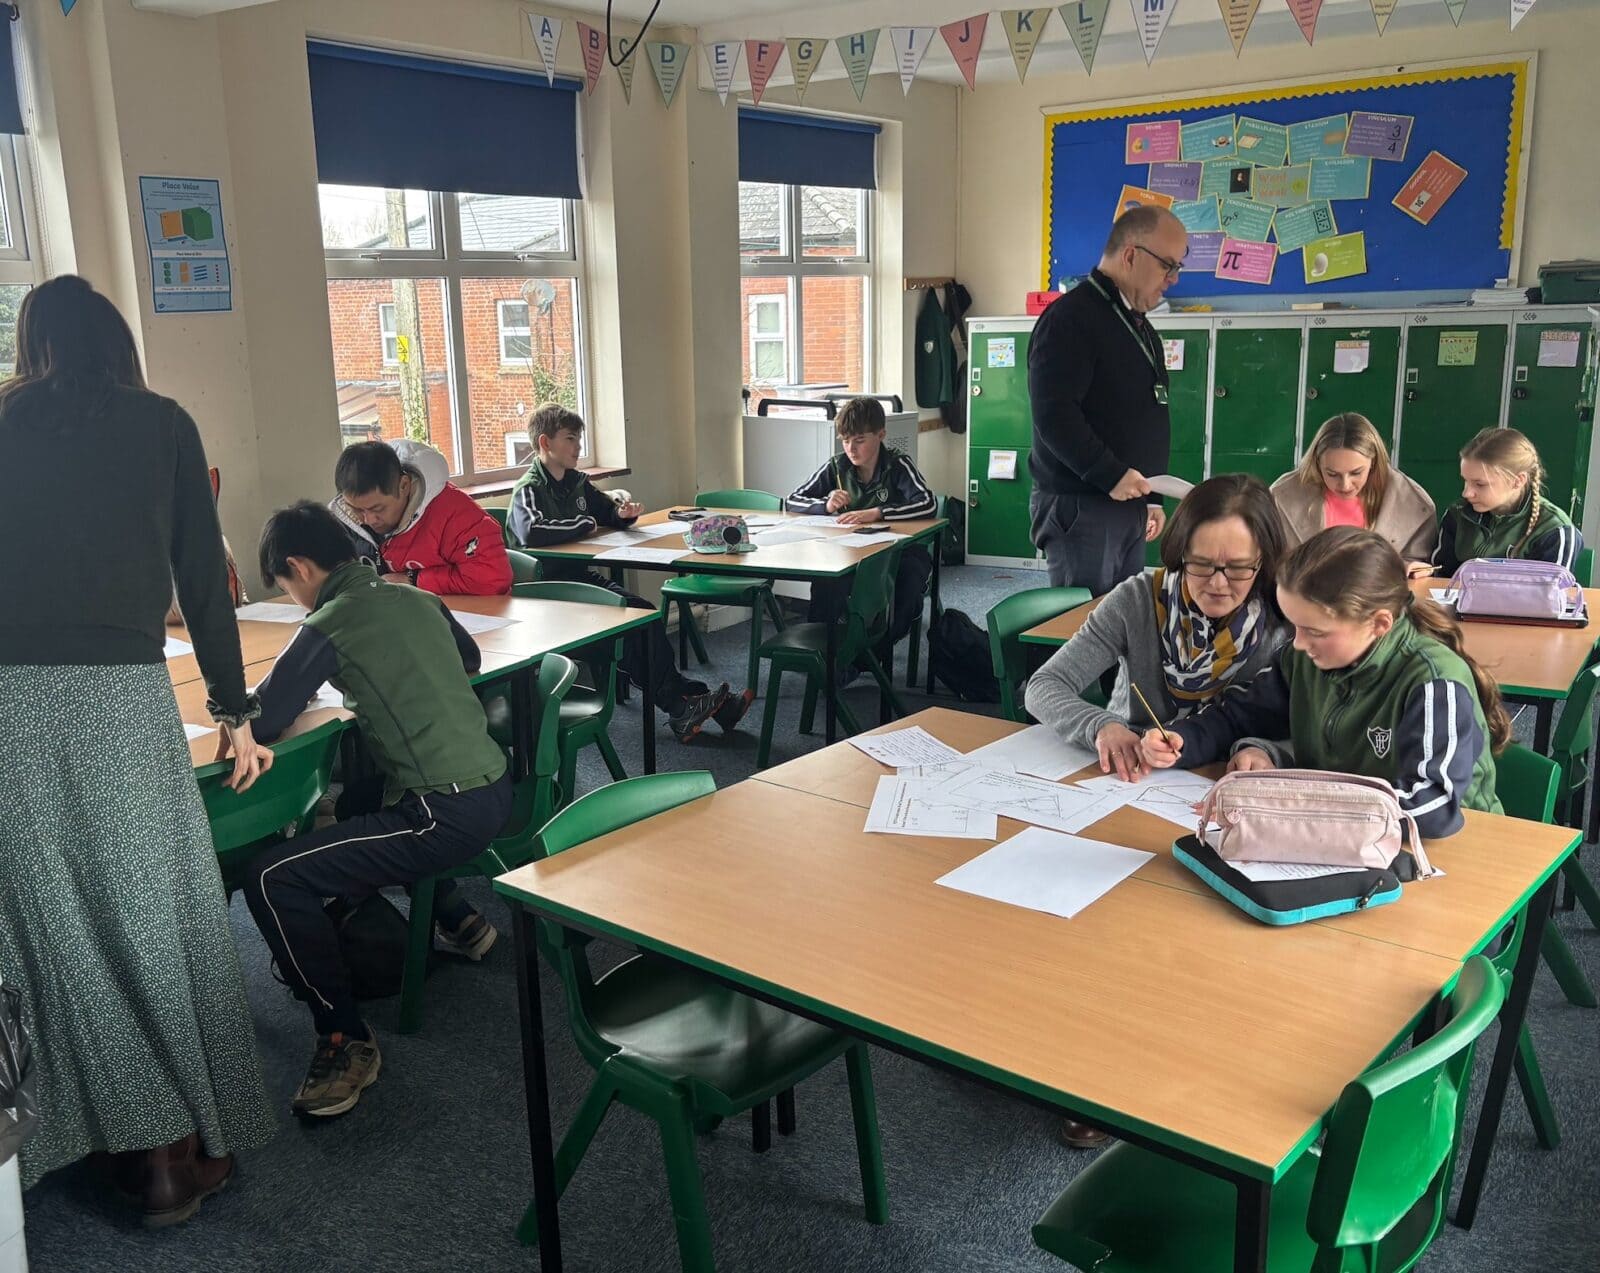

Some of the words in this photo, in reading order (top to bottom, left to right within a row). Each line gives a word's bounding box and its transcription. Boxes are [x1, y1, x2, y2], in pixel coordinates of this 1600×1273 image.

[1078, 3, 1093, 24] L
[1144, 0, 1163, 12] M
[540, 17, 553, 38] A
[1017, 10, 1034, 33] K
[589, 29, 599, 50] B
[908, 29, 914, 49] I
[959, 21, 969, 43] J
[619, 38, 628, 57] C
[661, 44, 675, 63] D
[715, 44, 727, 64] E
[757, 43, 768, 62] F
[798, 40, 812, 60] G
[850, 34, 865, 56] H
[1392, 125, 1402, 138] 3
[1388, 142, 1396, 154] 4
